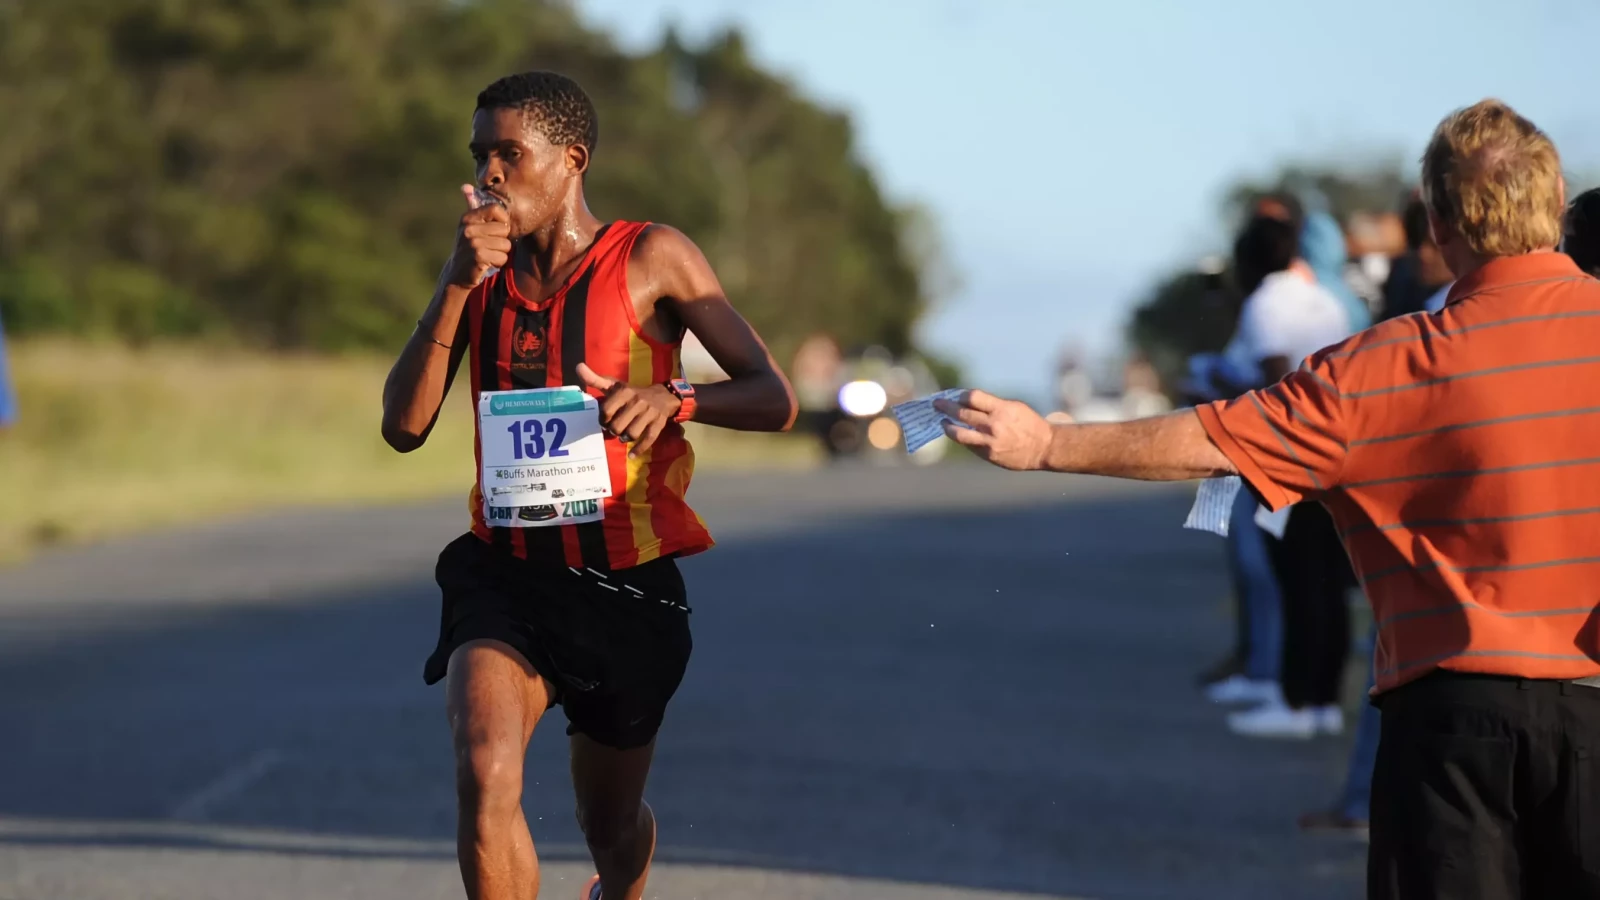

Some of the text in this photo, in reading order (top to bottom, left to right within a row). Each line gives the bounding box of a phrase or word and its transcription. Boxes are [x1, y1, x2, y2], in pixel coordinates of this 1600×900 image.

[505, 399, 546, 407] HEMINGWAYS
[507, 418, 569, 459] 132
[503, 465, 595, 479] Buffs Marathon 2016
[562, 498, 598, 518] 2016
